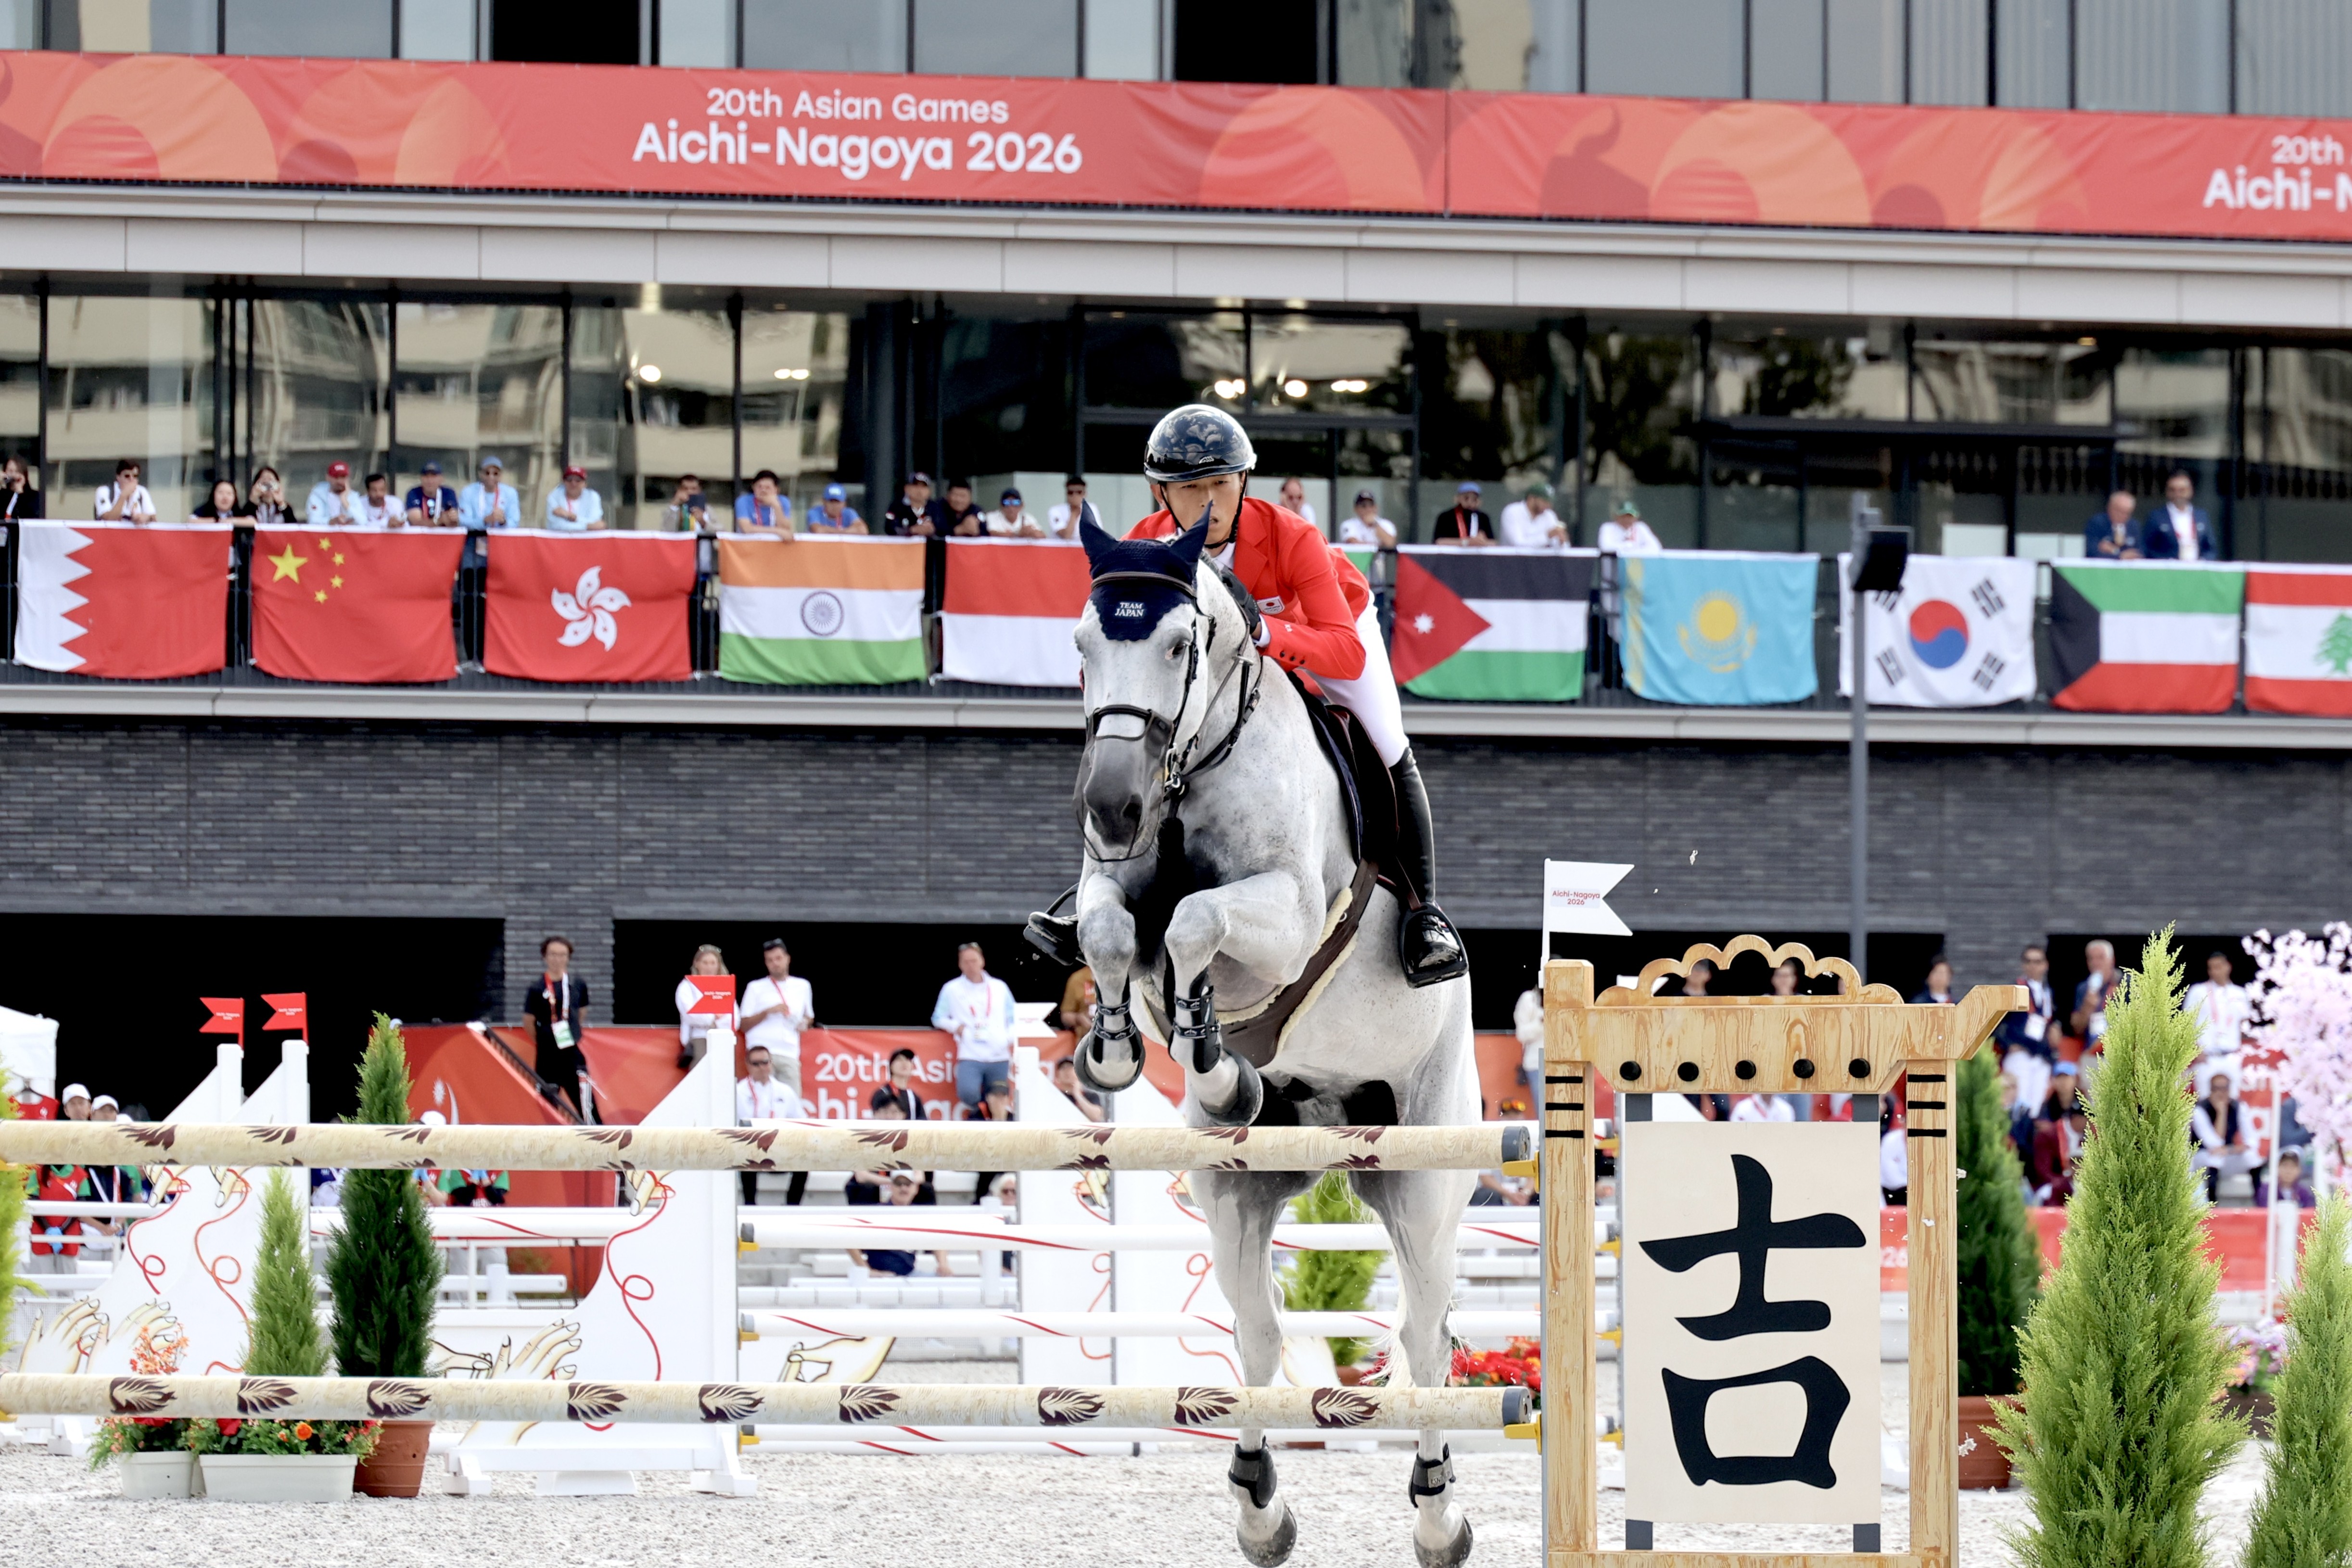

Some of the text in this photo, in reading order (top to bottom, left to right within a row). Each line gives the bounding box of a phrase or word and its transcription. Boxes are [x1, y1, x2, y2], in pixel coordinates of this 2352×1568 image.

[707, 88, 1010, 123] 20th Asian Games
[632, 118, 1082, 181] Aichi-Nagoya 2026
[2272, 135, 2344, 165] 20th
[1115, 609, 1144, 617] JAPAN
[1552, 890, 1600, 900] Aichi-Nagoya
[814, 1051, 890, 1082] 20th
[1638, 1154, 1867, 1490] 吉
